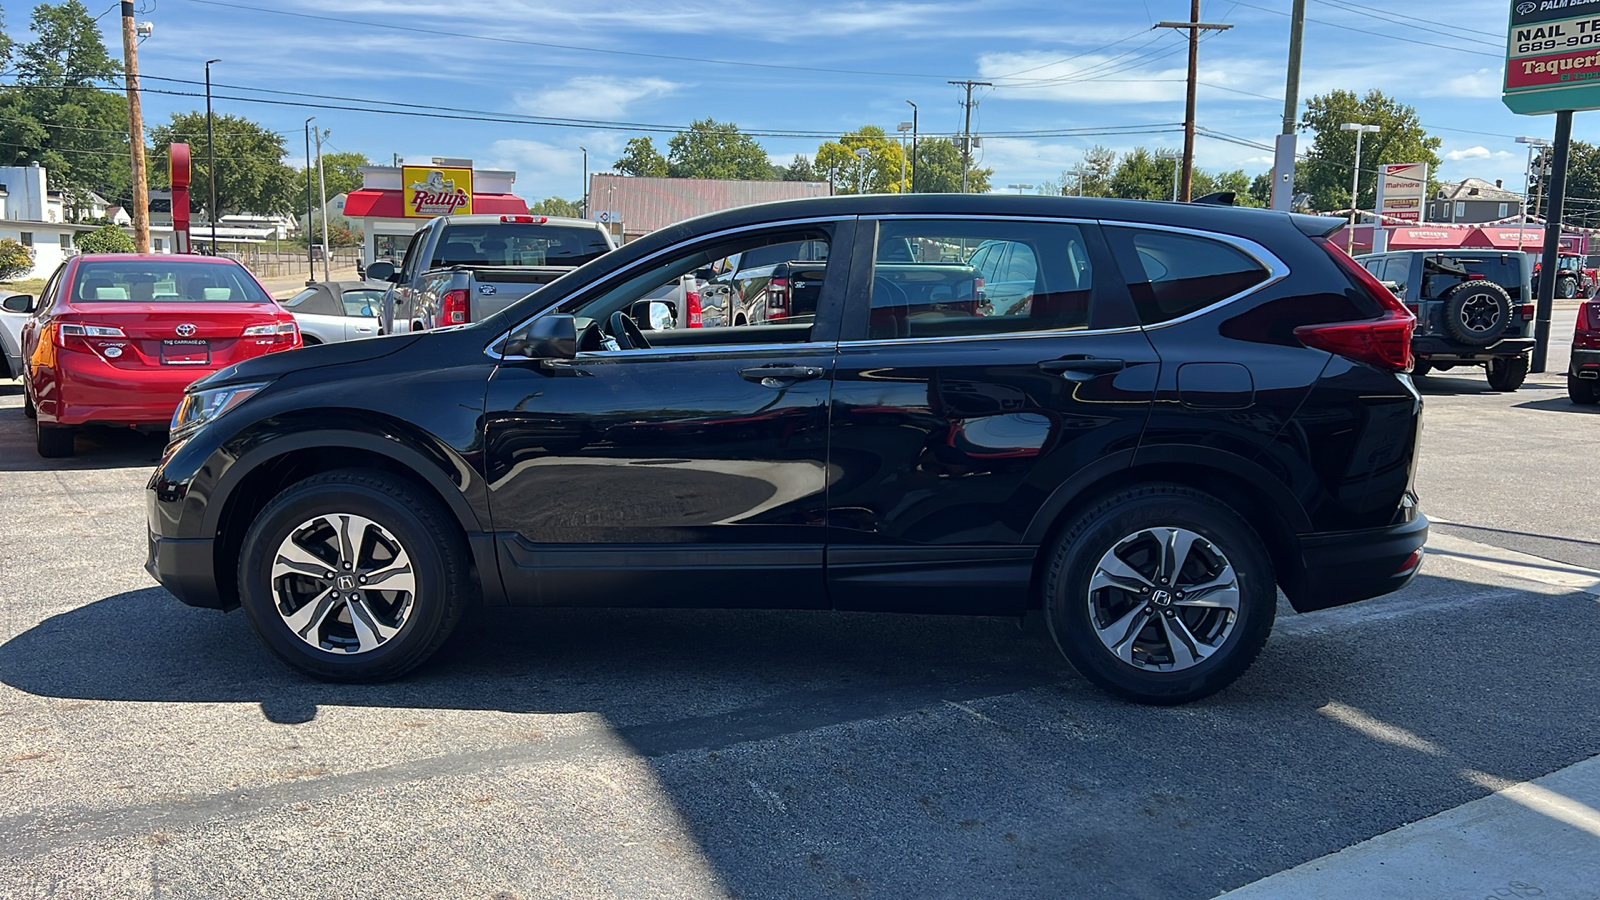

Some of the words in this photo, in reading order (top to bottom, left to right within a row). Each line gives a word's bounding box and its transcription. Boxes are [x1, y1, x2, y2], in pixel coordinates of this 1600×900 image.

[1540, 0, 1568, 11] PALM
[1517, 25, 1566, 42] NAIL
[410, 188, 467, 214] Rally's
